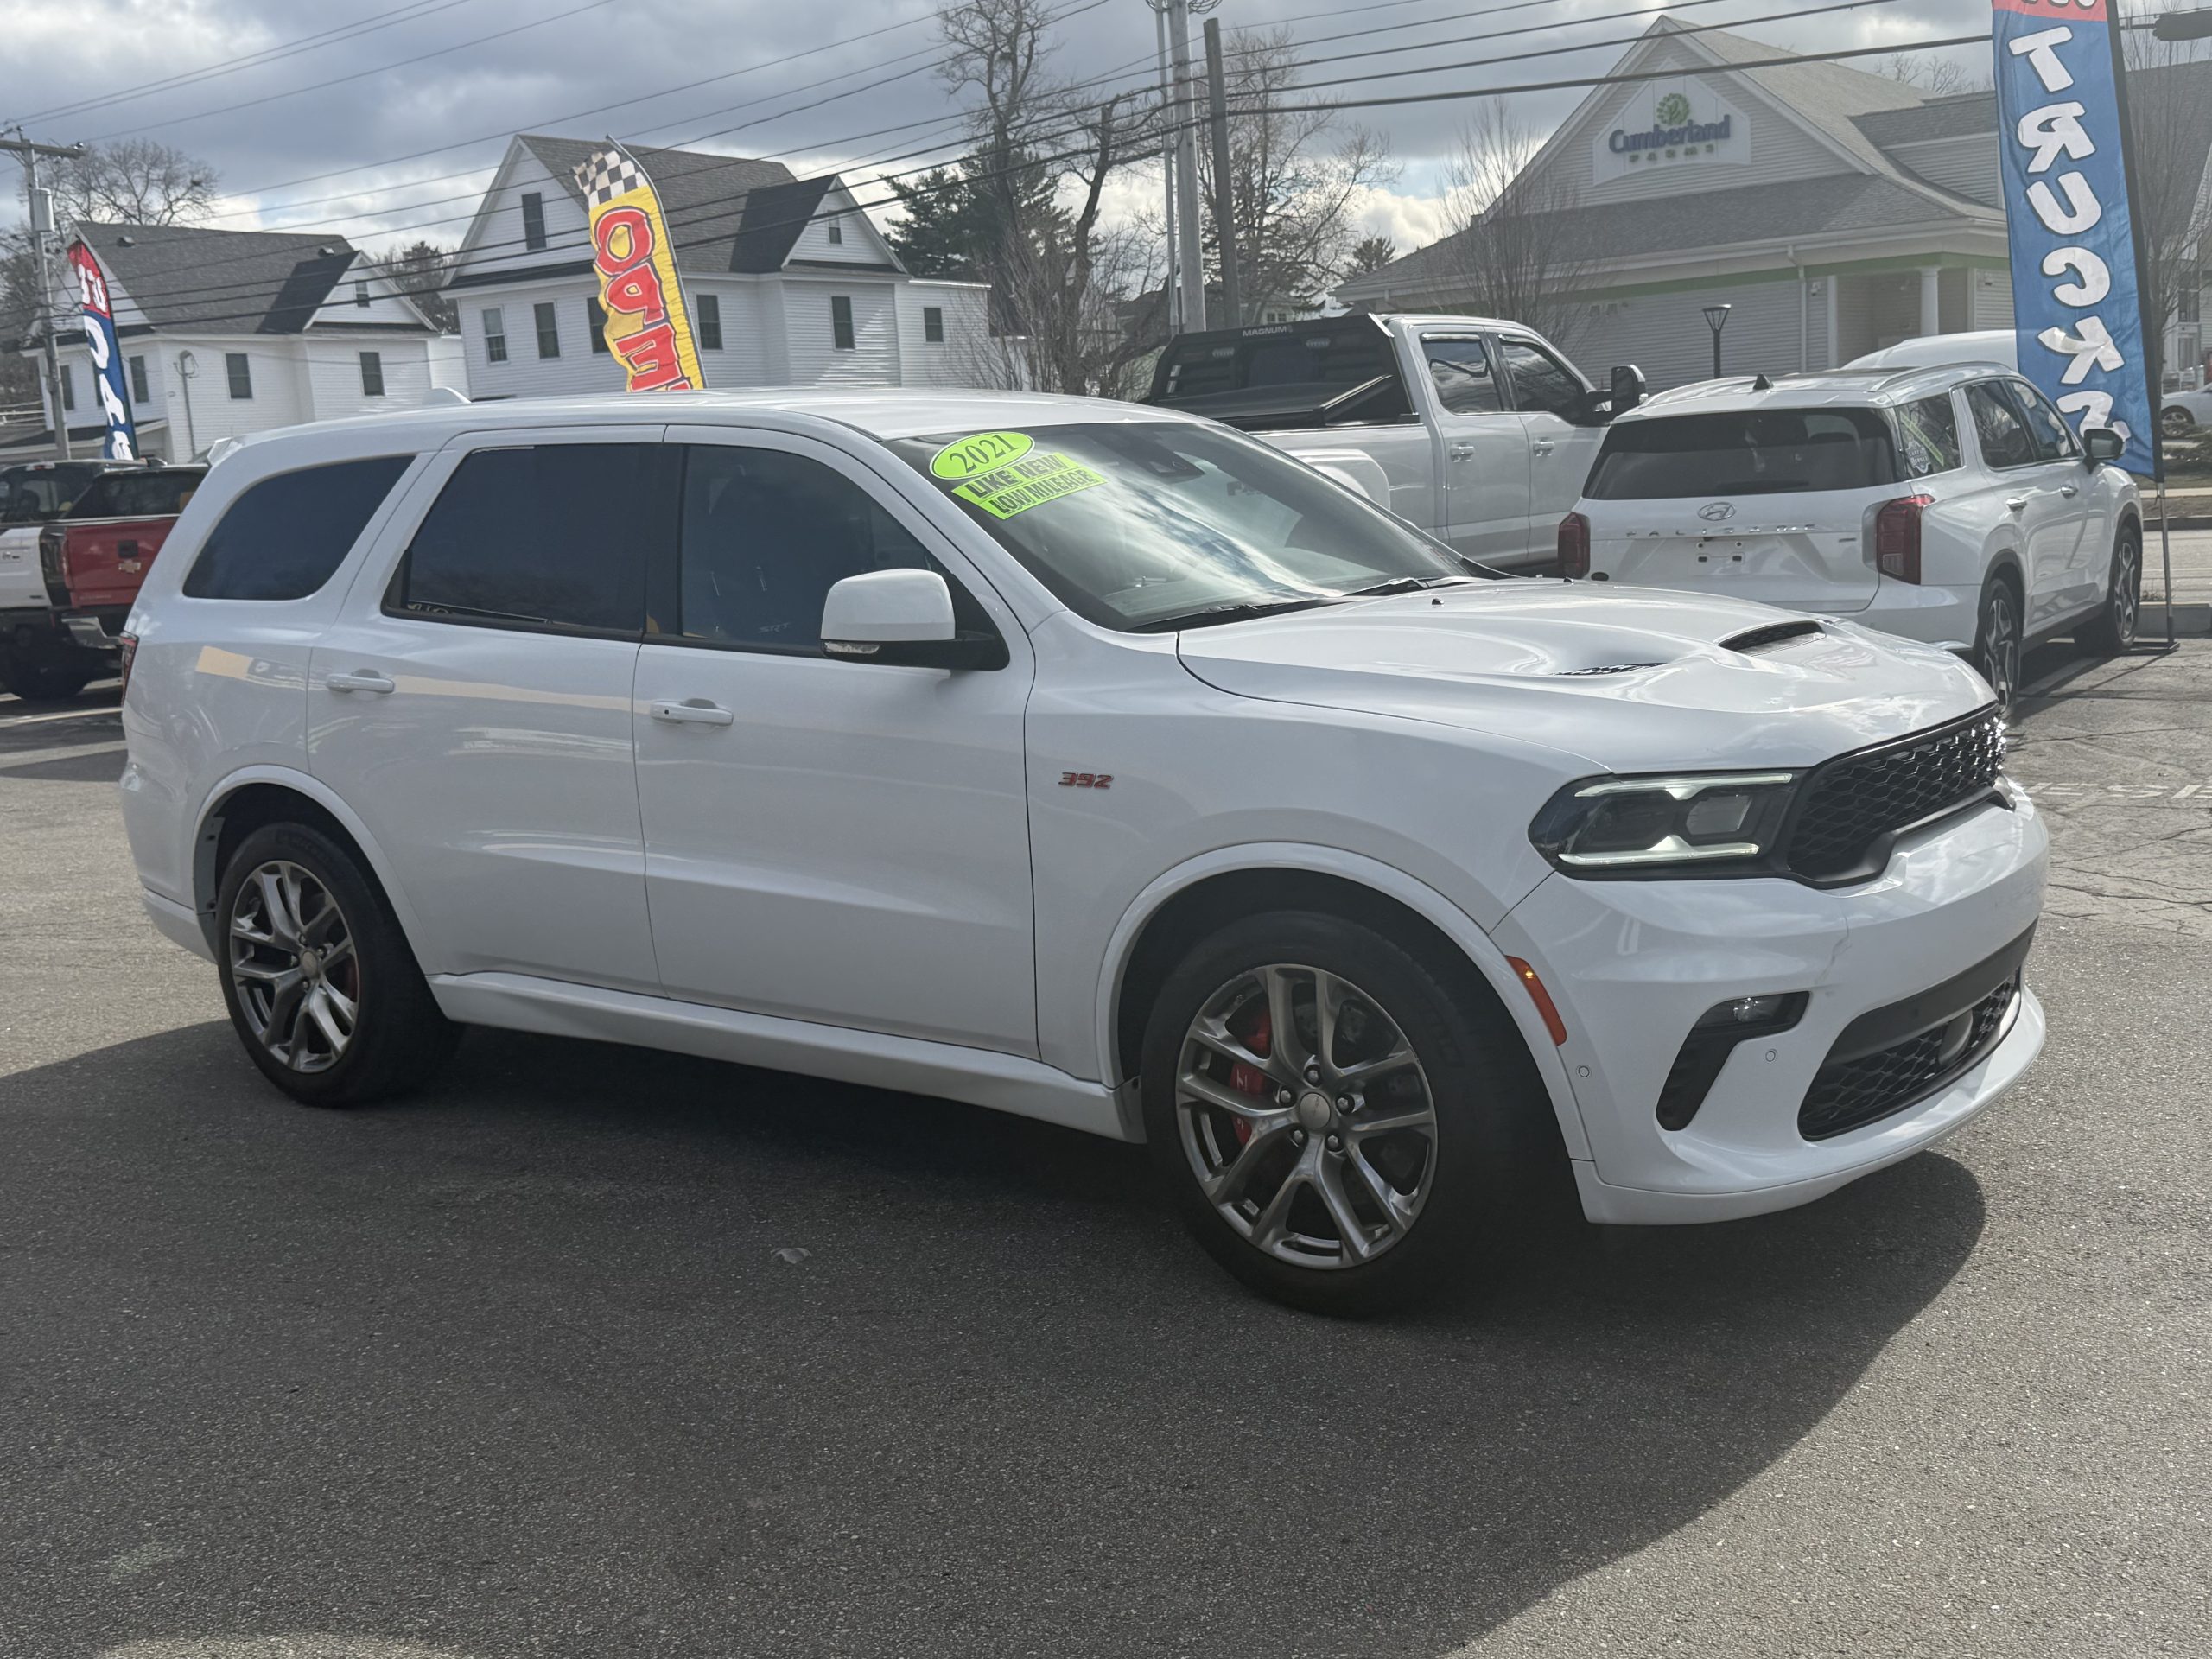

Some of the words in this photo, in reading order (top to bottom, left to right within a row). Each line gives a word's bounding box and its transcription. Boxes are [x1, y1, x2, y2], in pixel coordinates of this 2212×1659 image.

[1609, 114, 1731, 154] Cumberland
[1243, 326, 1287, 337] MAGNUM
[950, 435, 1019, 473] 2021
[963, 469, 1019, 499] LIKE
[1012, 454, 1068, 479] NEW
[988, 489, 1031, 515] LOW
[1028, 469, 1095, 501] MILEAGE
[1058, 772, 1114, 789] 392
